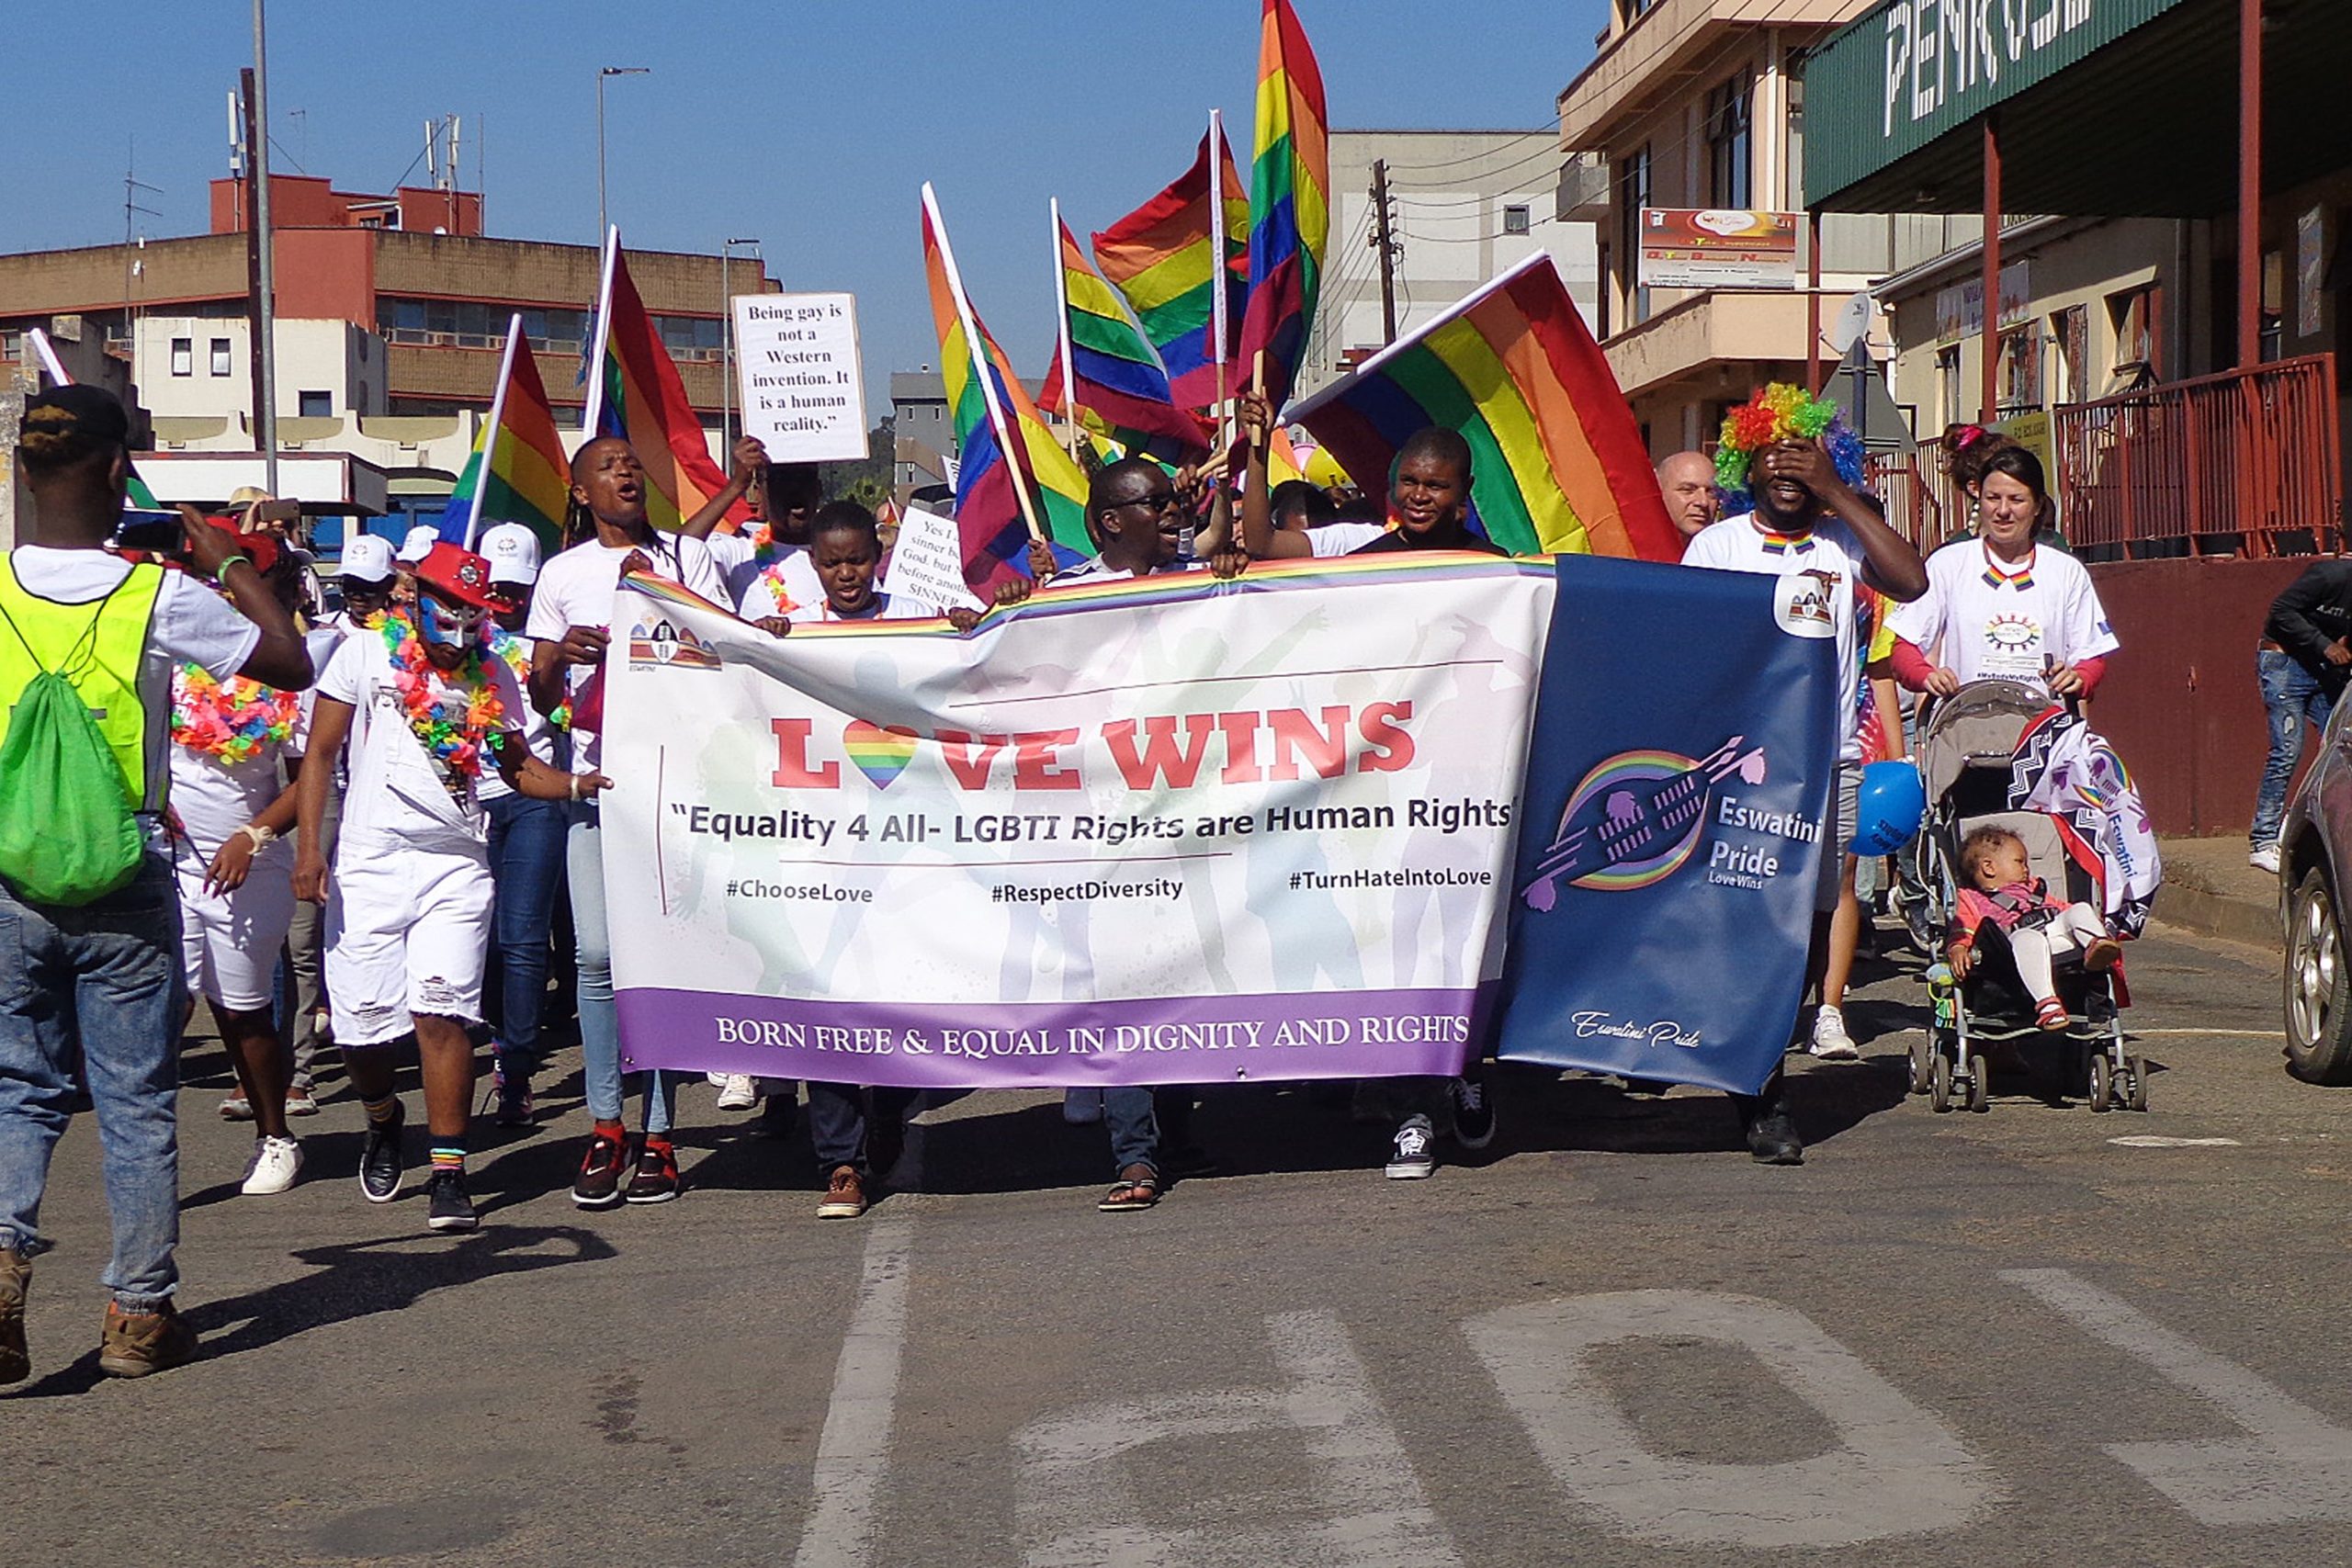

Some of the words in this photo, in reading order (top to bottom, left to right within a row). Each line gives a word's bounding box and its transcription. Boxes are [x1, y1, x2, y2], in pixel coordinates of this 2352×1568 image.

[749, 306, 794, 322] Being
[797, 307, 825, 322] gay
[830, 304, 842, 317] is
[778, 330, 803, 342] not
[808, 331, 817, 341] a
[766, 350, 832, 365] Western
[753, 374, 832, 389] invention.
[837, 371, 849, 384] It
[760, 396, 773, 410] is
[777, 399, 786, 410] a
[792, 394, 846, 409] human
[924, 521, 943, 536] Yes
[911, 536, 944, 555] sinner
[898, 563, 934, 583] before
[933, 558, 952, 574] but
[908, 582, 959, 607] SINNER
[1100, 700, 1416, 791] WINS
[847, 814, 869, 841] 4
[954, 815, 1059, 843] LGBTI
[1071, 812, 1184, 846] Rights
[1195, 815, 1254, 838] are
[1266, 802, 1395, 833] Human
[1718, 795, 1824, 843] Eswatini
[2108, 814, 2138, 879] Eswatini
[1710, 840, 1779, 877] Pride
[726, 879, 874, 904] #ChooseLove
[991, 878, 1184, 906] #RespectDiversity
[1289, 867, 1492, 891] #TurnHateIntoLove
[715, 1016, 808, 1048] BORN
[814, 1025, 894, 1055] FREE
[901, 1029, 934, 1055] &
[941, 1028, 1059, 1060] EQUAL
[1067, 1027, 1105, 1055] IN
[1114, 1021, 1263, 1054] DIGNITY
[1273, 1017, 1351, 1048] AND
[1359, 1014, 1470, 1045] RIGHTS
[1570, 1010, 1646, 1039] Eswatini
[1648, 1021, 1701, 1048] Pride
